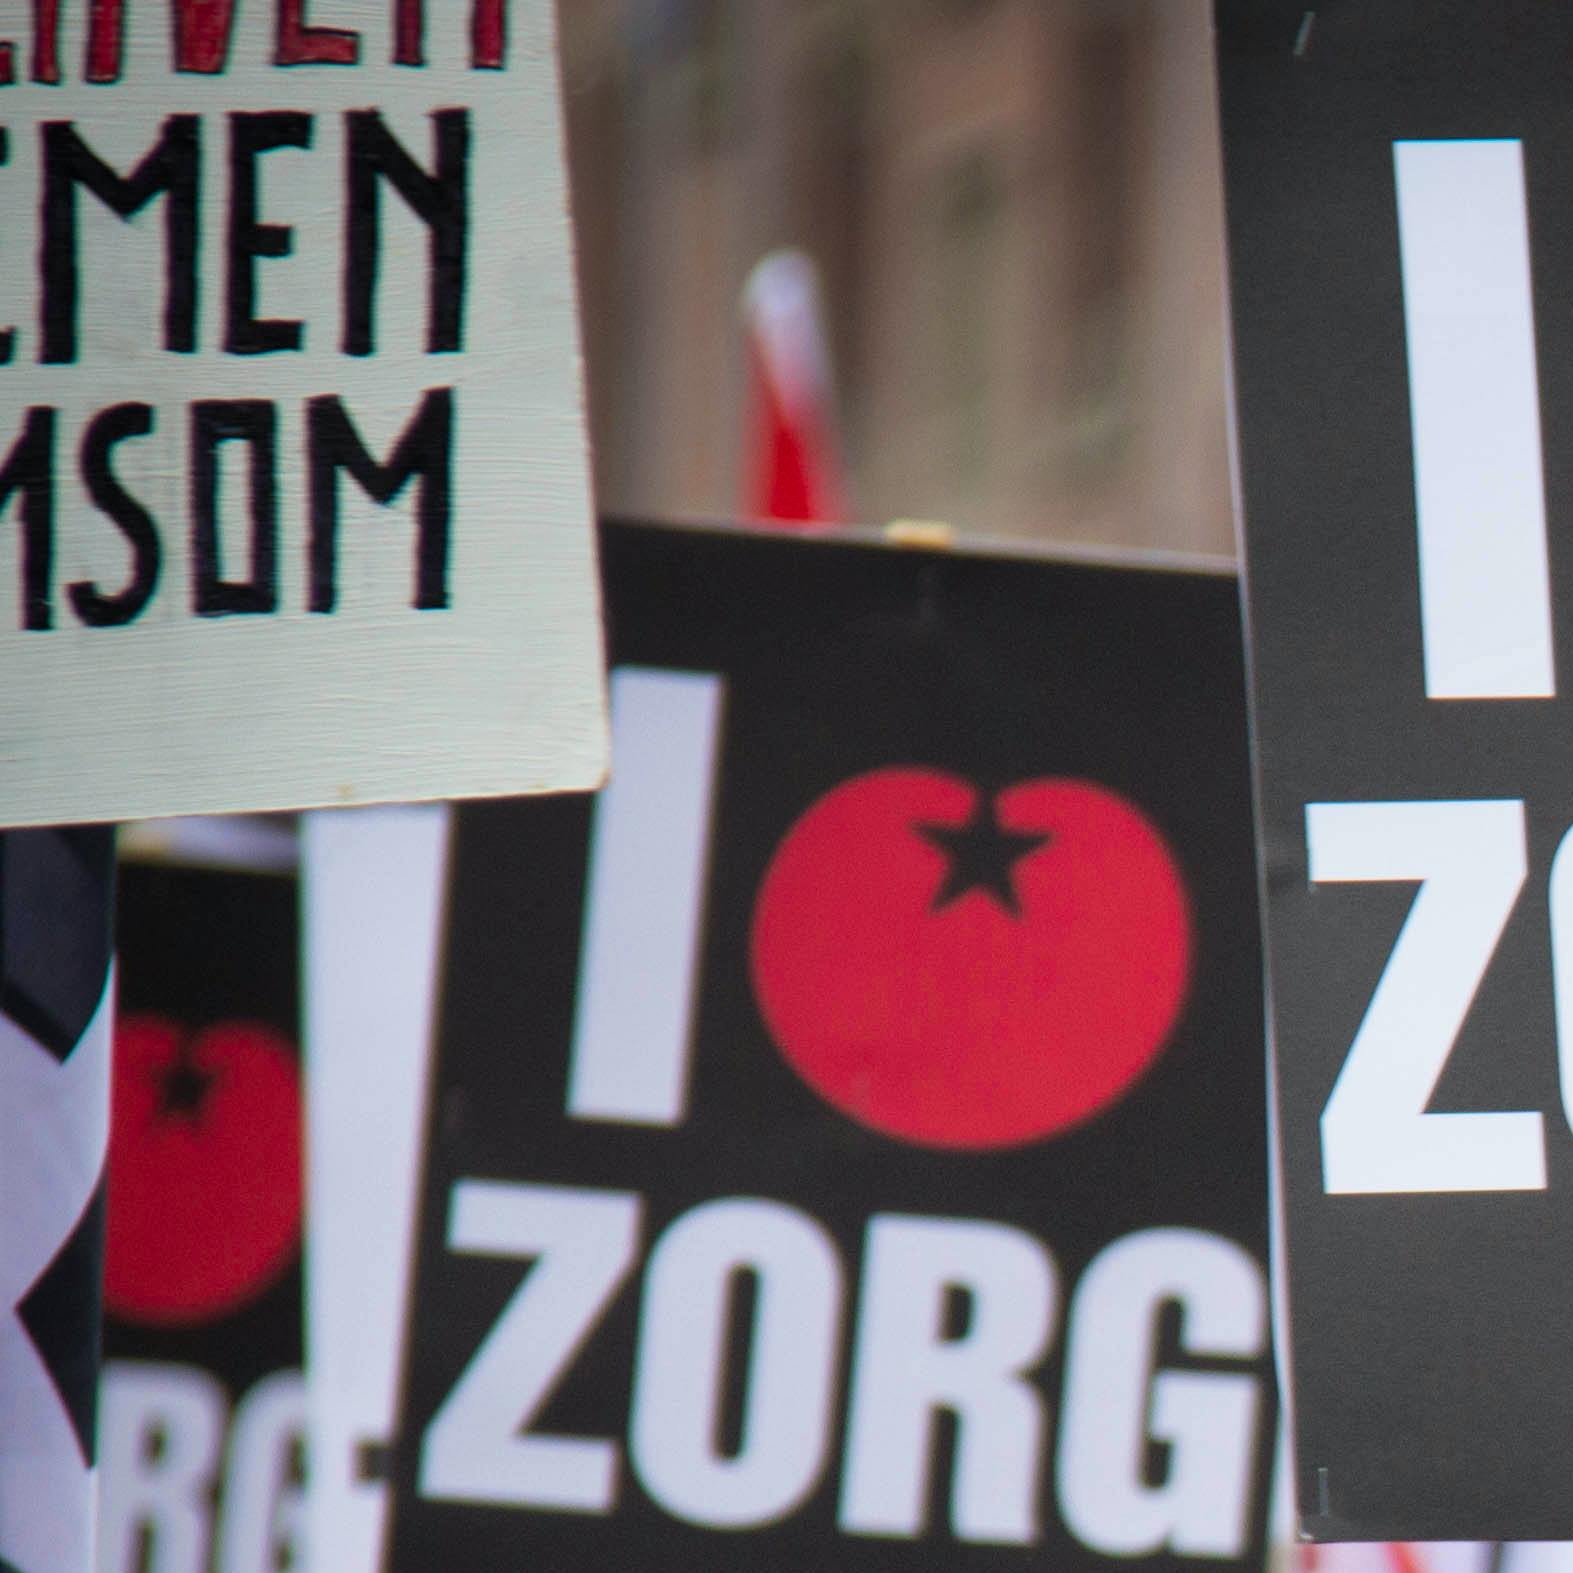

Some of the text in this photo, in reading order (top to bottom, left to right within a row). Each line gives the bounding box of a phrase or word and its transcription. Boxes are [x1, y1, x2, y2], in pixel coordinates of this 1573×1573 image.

[0, 107, 470, 365] MEN
[1392, 138, 1556, 699] I
[564, 665, 726, 1126] I
[416, 1176, 1267, 1561] ZORG
